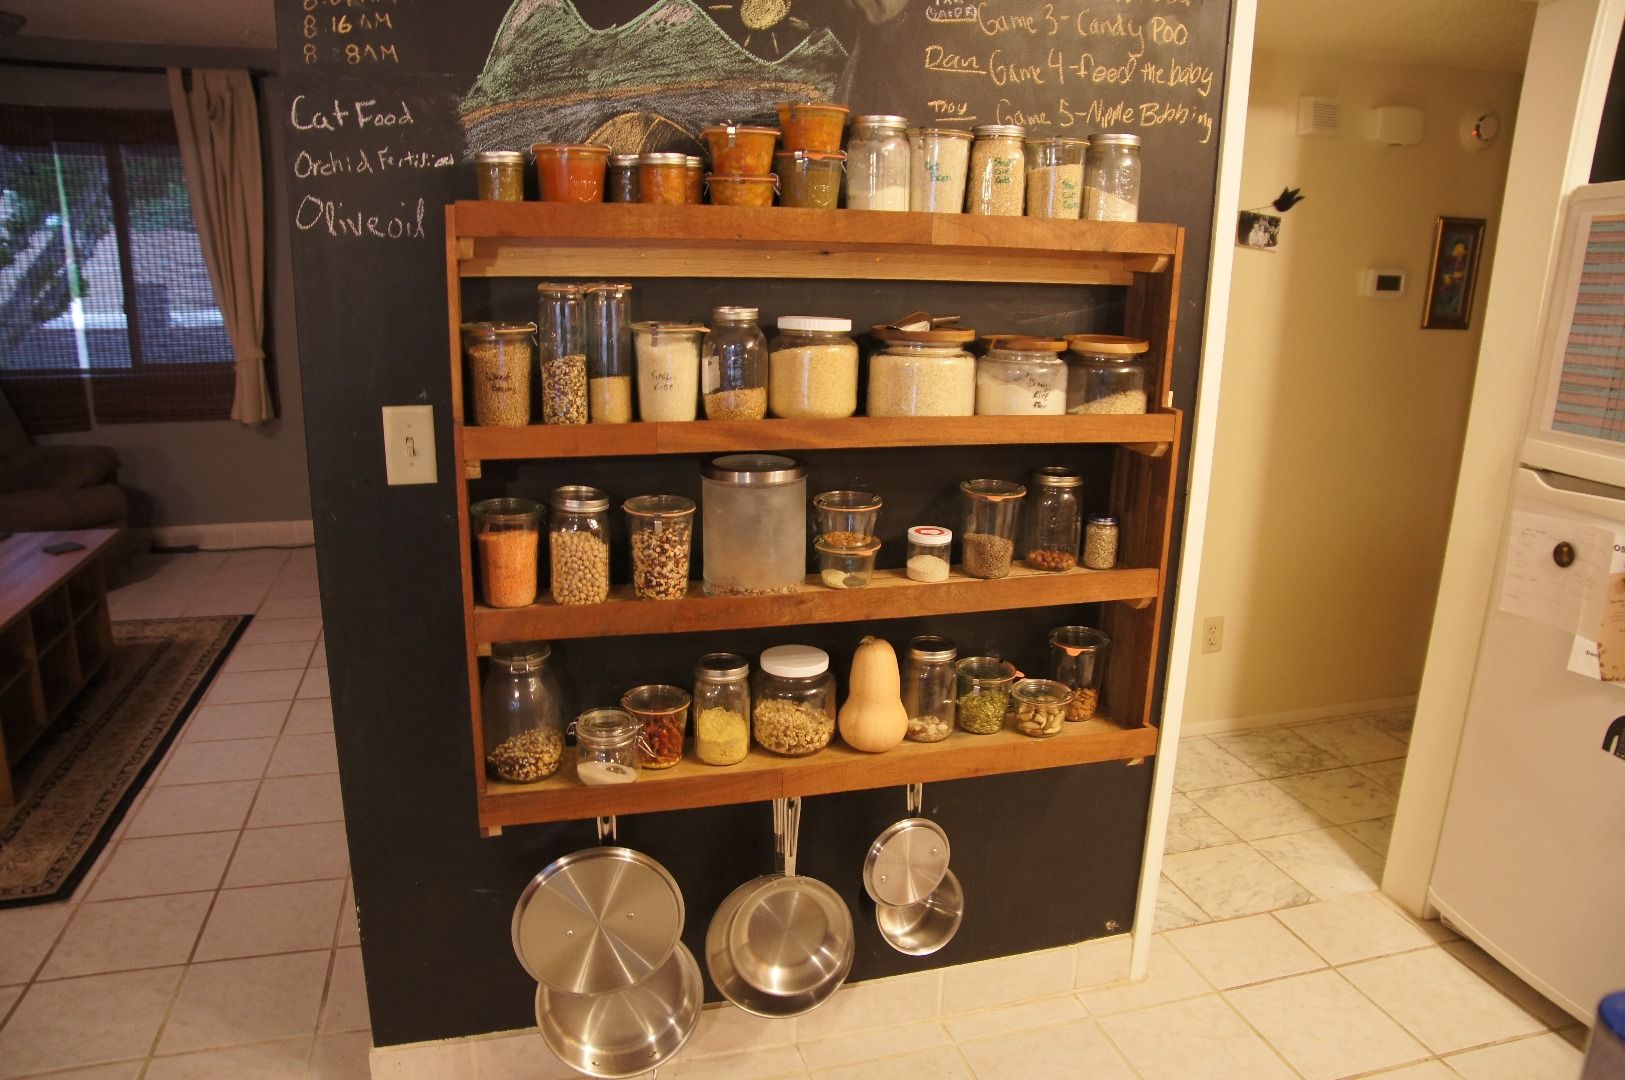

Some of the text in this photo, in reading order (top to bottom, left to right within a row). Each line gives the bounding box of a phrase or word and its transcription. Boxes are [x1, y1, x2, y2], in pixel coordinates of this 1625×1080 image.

[978, 2, 1038, 36] Game
[924, 44, 980, 69] Dan
[989, 49, 1046, 87] Game
[1141, 61, 1166, 85] the
[1167, 57, 1213, 97] baby
[290, 95, 415, 132] Cat Food
[996, 98, 1051, 126] Game
[294, 149, 374, 179] Orchid
